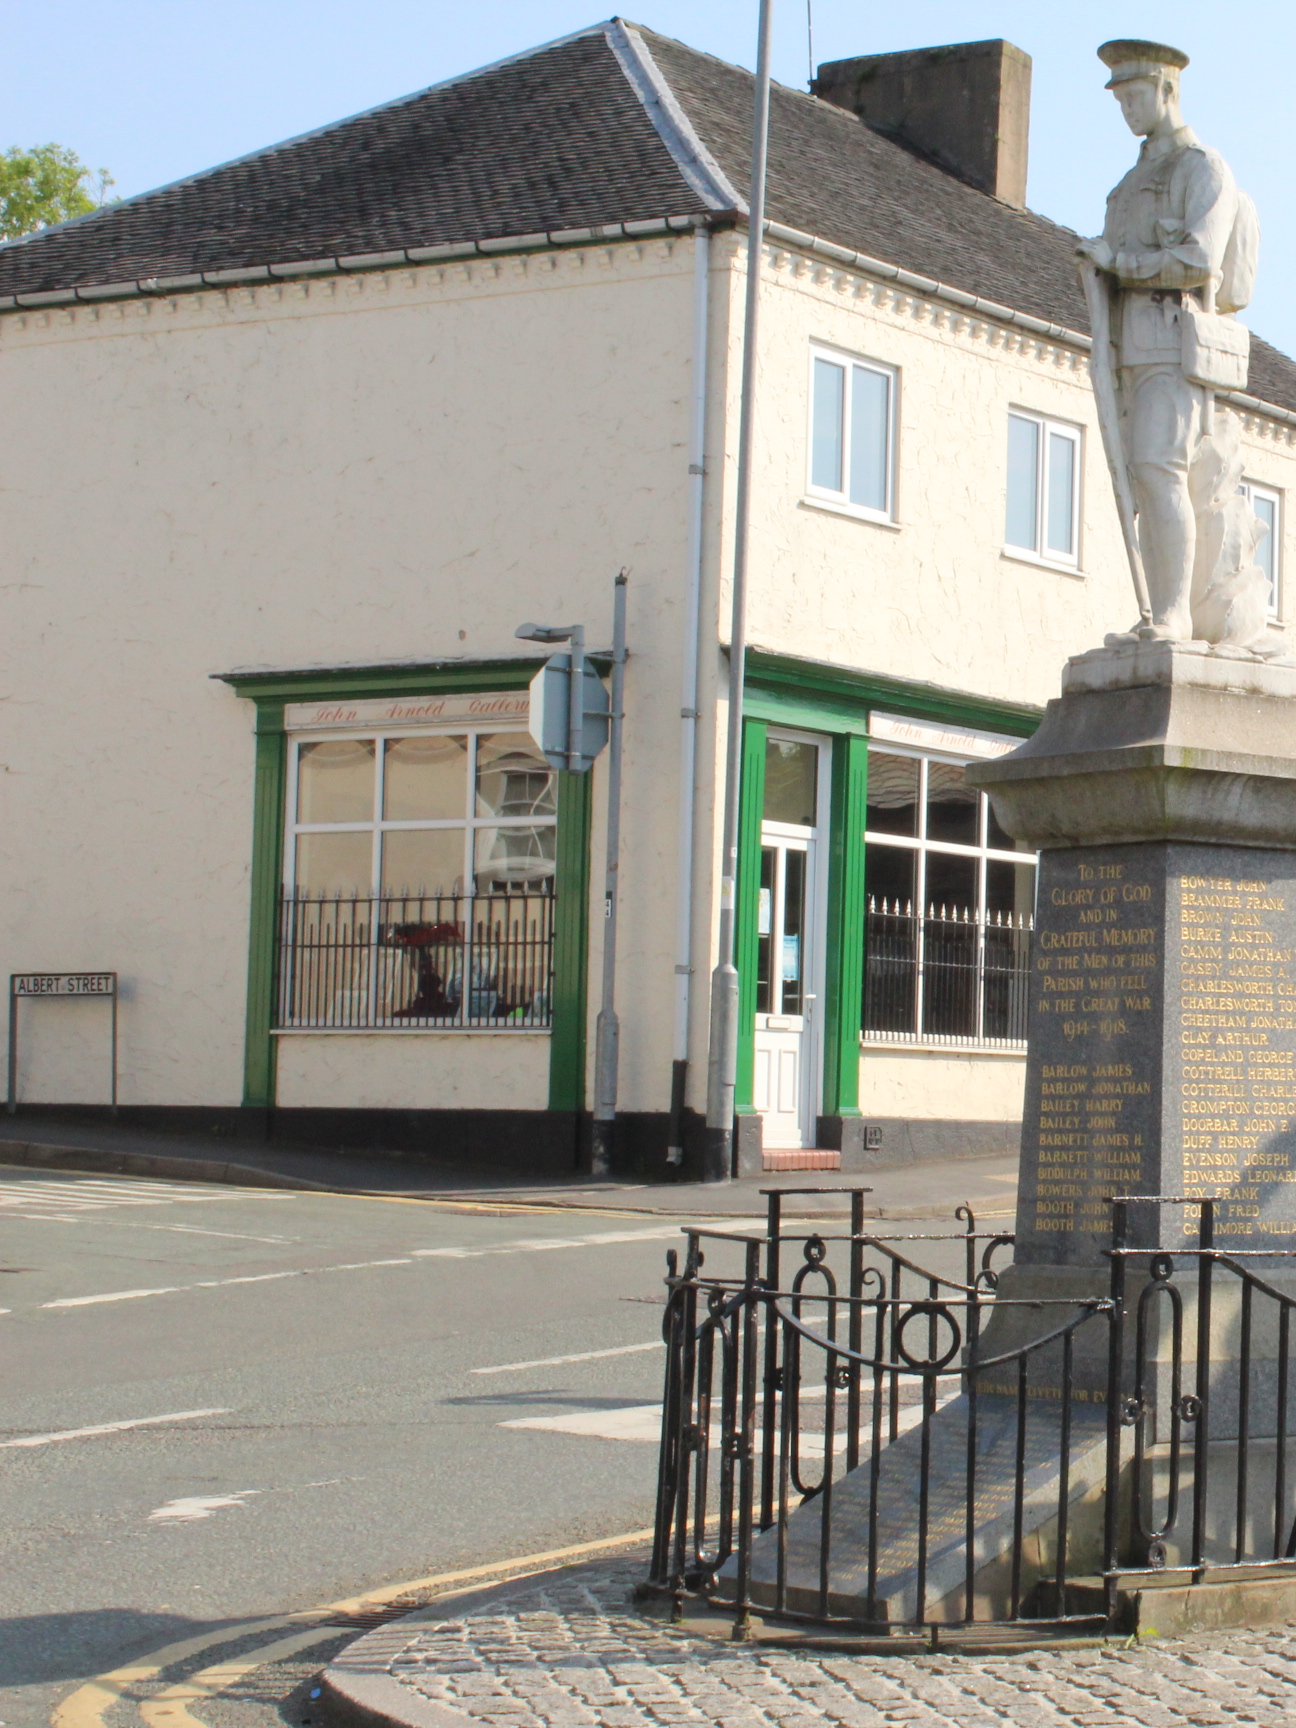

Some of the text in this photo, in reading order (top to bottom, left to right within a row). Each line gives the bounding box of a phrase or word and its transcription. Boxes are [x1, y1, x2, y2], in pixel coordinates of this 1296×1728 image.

[311, 707, 358, 722] John
[379, 702, 445, 719] Arnold
[889, 721, 1016, 754] John Arnold Gall
[1100, 865, 1122, 879] THE
[1180, 876, 1267, 892] BOWYER JOHN
[1052, 884, 1151, 906] GLORY OF GOD
[1180, 893, 1284, 910] BRAMMER FRANK
[1079, 909, 1117, 923] AND IN
[1181, 910, 1261, 926] BROWN JOHN
[1041, 928, 1157, 949] GRATEFUL MEMORY
[1181, 927, 1273, 943] BURKE AUSTIN
[1181, 945, 1222, 959] CAMM
[1229, 947, 1291, 962] JONATHAN
[1038, 953, 1156, 970] OF THE MEN OF THIS
[1181, 962, 1222, 976] CASEY
[1229, 964, 1272, 977] JAMES
[18, 977, 110, 992] ALBERT STREET
[1044, 975, 1147, 992] PARISH WHO FELL
[1181, 979, 1274, 994] CHARLESWORTH
[1038, 996, 1150, 1012] IN THE GREAT WAR
[1181, 997, 1274, 1011] CHARLESWORTH
[1181, 1014, 1246, 1027] CHEETHAM
[1182, 1031, 1268, 1045] CLAY ARTHUR
[1181, 1049, 1243, 1063] COPELAND
[1249, 1051, 1294, 1063] GEORGE
[1042, 1064, 1133, 1078] BARLOW JAMES
[1182, 1067, 1244, 1080] COTTRELL
[1042, 1082, 1150, 1095] BARLOW JONATHAN
[1182, 1084, 1246, 1097] COTTERILL
[1041, 1099, 1123, 1112] BAILEY HARRY
[1182, 1101, 1249, 1114] CROMPTON
[1040, 1117, 1116, 1129] BAILEY JOHN
[1182, 1118, 1239, 1131] DOORBAR
[1244, 1119, 1276, 1131] JOHN
[1039, 1134, 1089, 1146] BARNETT
[1093, 1134, 1129, 1146] JAMES
[1183, 1136, 1259, 1149] DUFF HENRY
[1039, 1151, 1141, 1164] BARNETT WILLIAM
[1183, 1153, 1289, 1166] EVENSON JOSEPH
[1038, 1168, 1087, 1180] BIDDULPH
[1183, 1170, 1240, 1183] EDWARDS
[1037, 1184, 1082, 1197] BOWERS
[1088, 1185, 1117, 1197] JOHN
[1216, 1188, 1259, 1199] FRANK
[1037, 1201, 1108, 1214] BOOTH JOHN
[1228, 1205, 1260, 1217] FRED
[1036, 1219, 1074, 1231] BOOTH
[1183, 1222, 1252, 1235] GAIMORE
